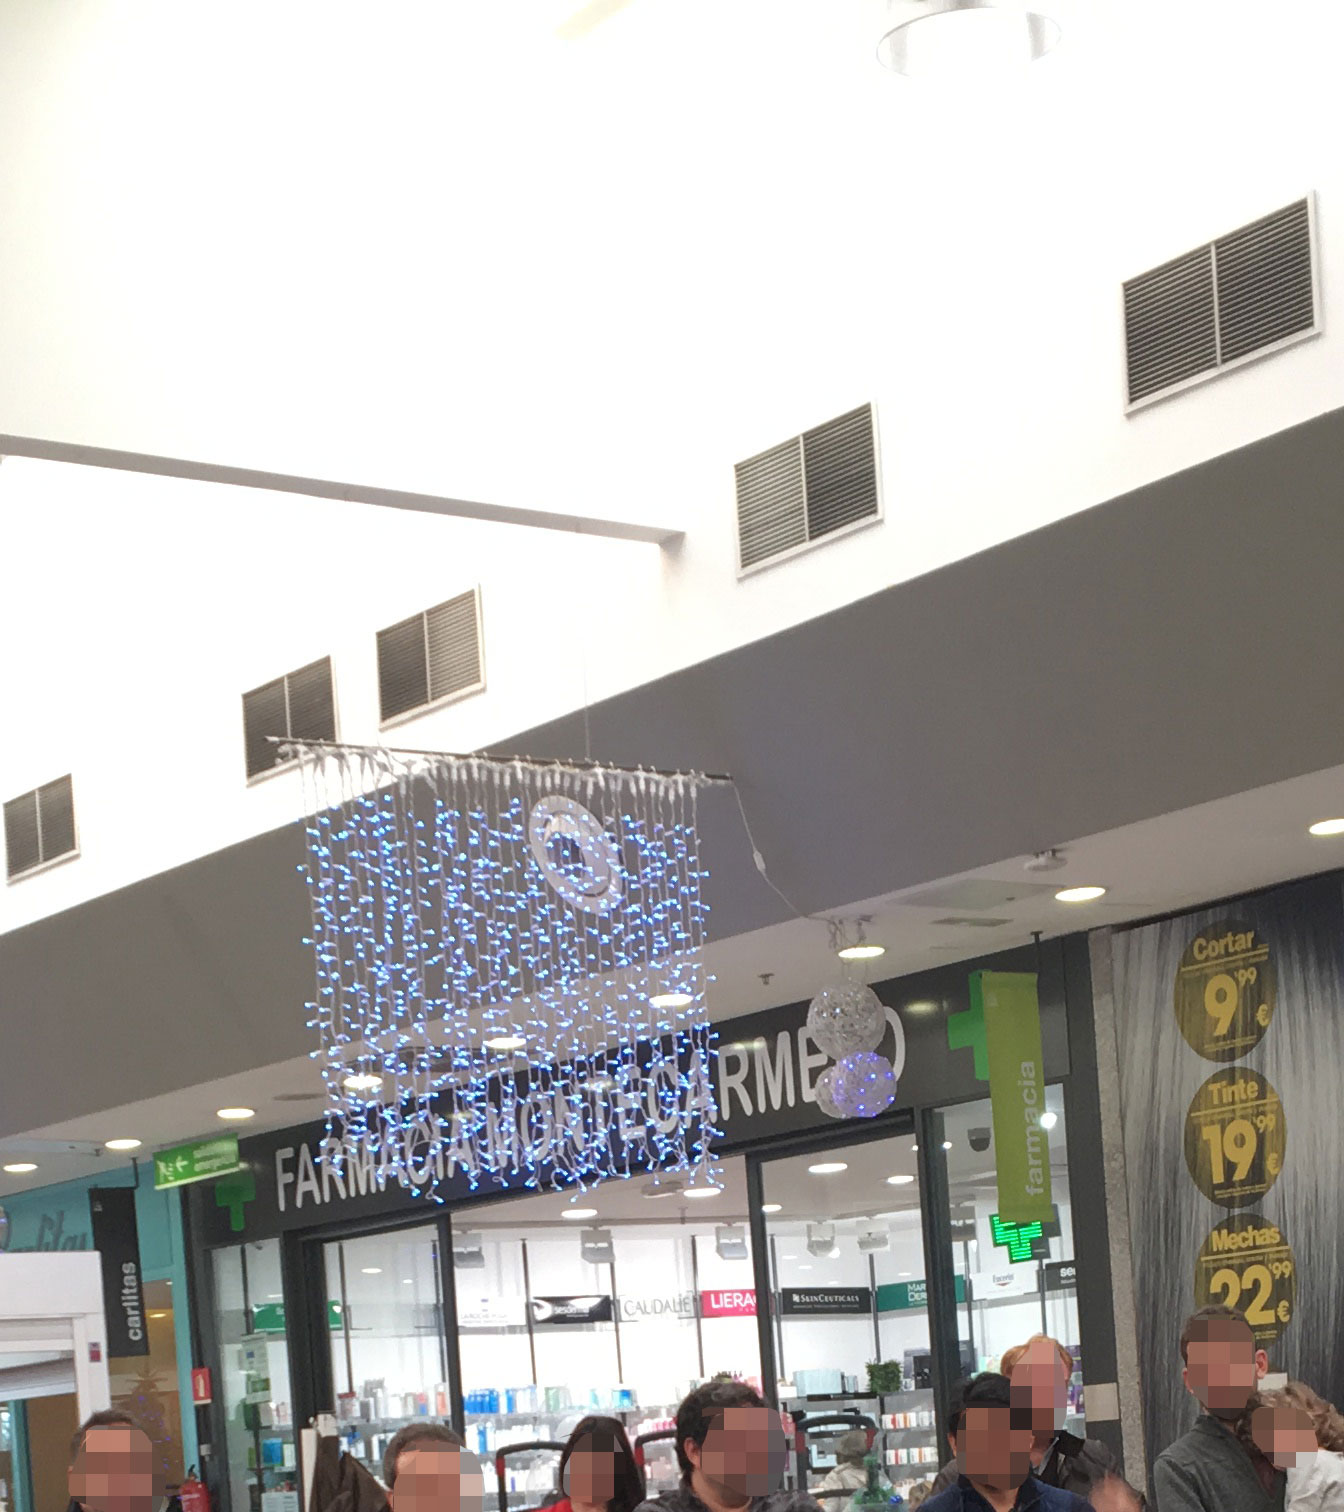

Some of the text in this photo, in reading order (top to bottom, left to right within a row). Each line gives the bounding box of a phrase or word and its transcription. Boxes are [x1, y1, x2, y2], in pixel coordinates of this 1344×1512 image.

[1193, 930, 1255, 961] Cortar
[1208, 1078, 1259, 1105] Tinte
[274, 1004, 906, 1212] FARMACIA MONTECARMEO
[1017, 1061, 1044, 1197] farmacia
[1211, 1225, 1281, 1252] Mechas
[121, 1261, 143, 1341] carlitas
[709, 1292, 757, 1309] LIERA
